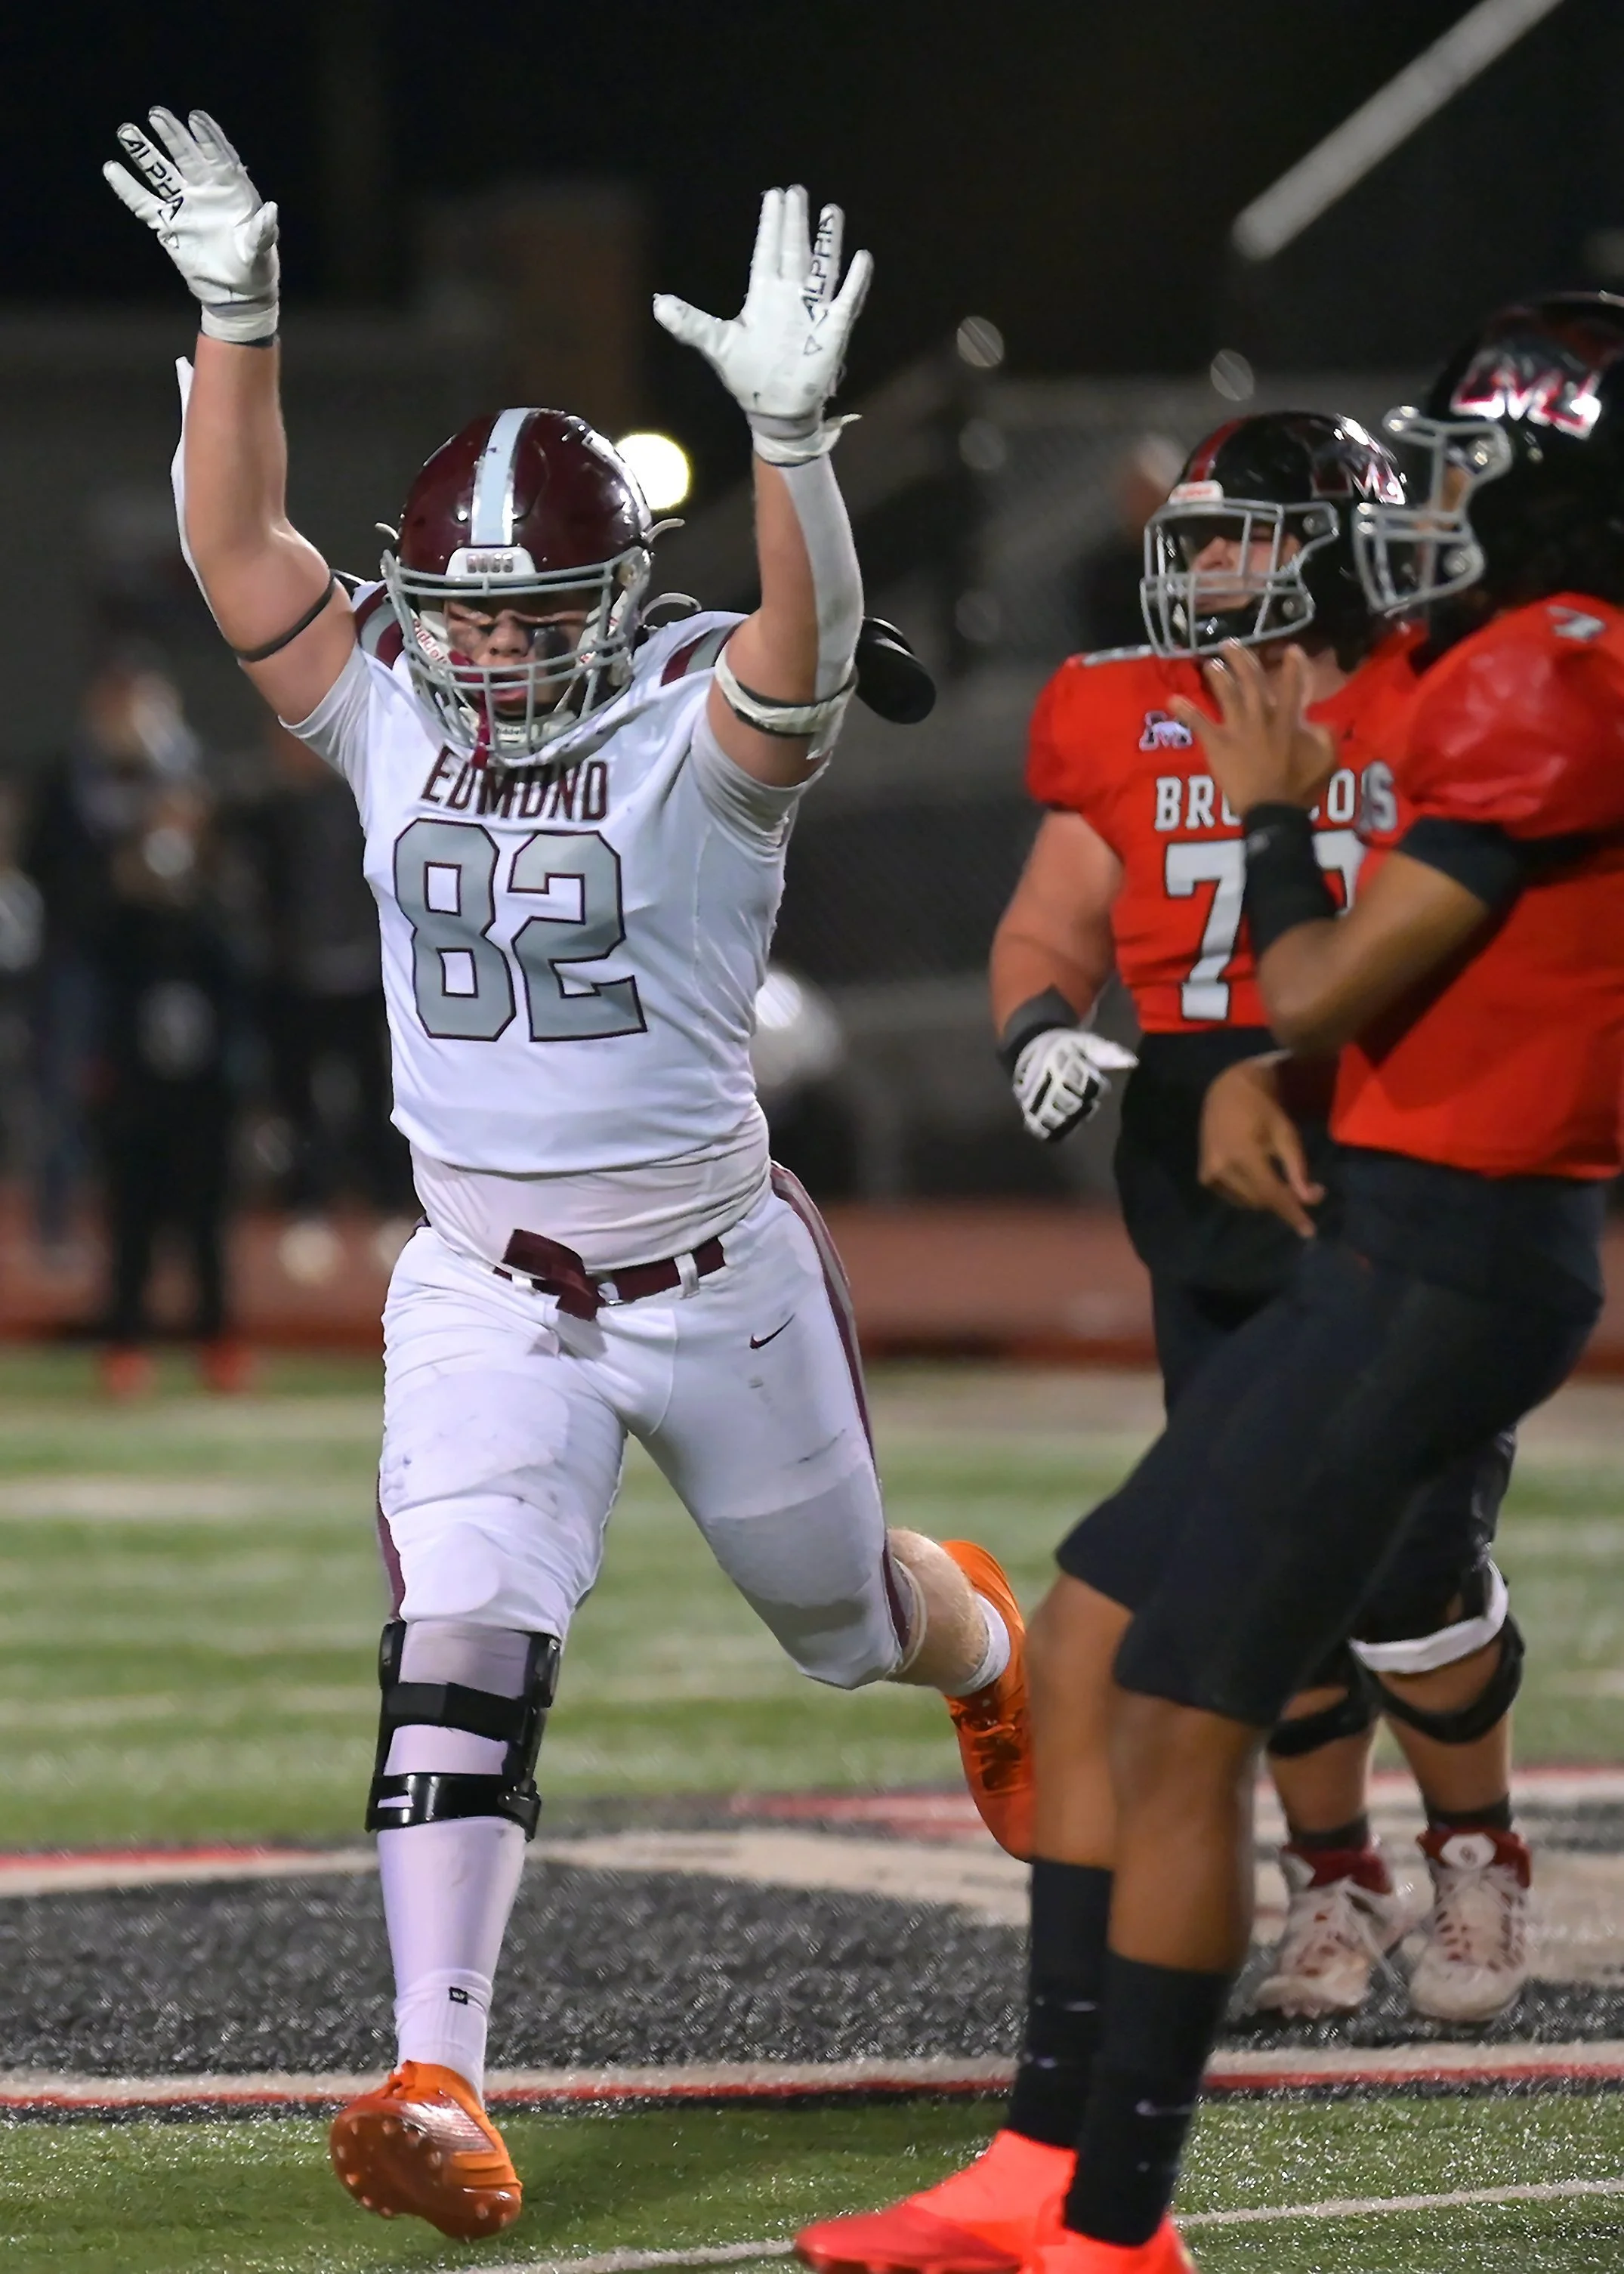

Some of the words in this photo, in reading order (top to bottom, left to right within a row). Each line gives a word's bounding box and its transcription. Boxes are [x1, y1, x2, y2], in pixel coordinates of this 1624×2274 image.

[120, 134, 184, 221] ALPHA
[801, 212, 834, 321] ALPHA
[420, 744, 609, 821] EDMOND
[392, 817, 648, 1042] 82
